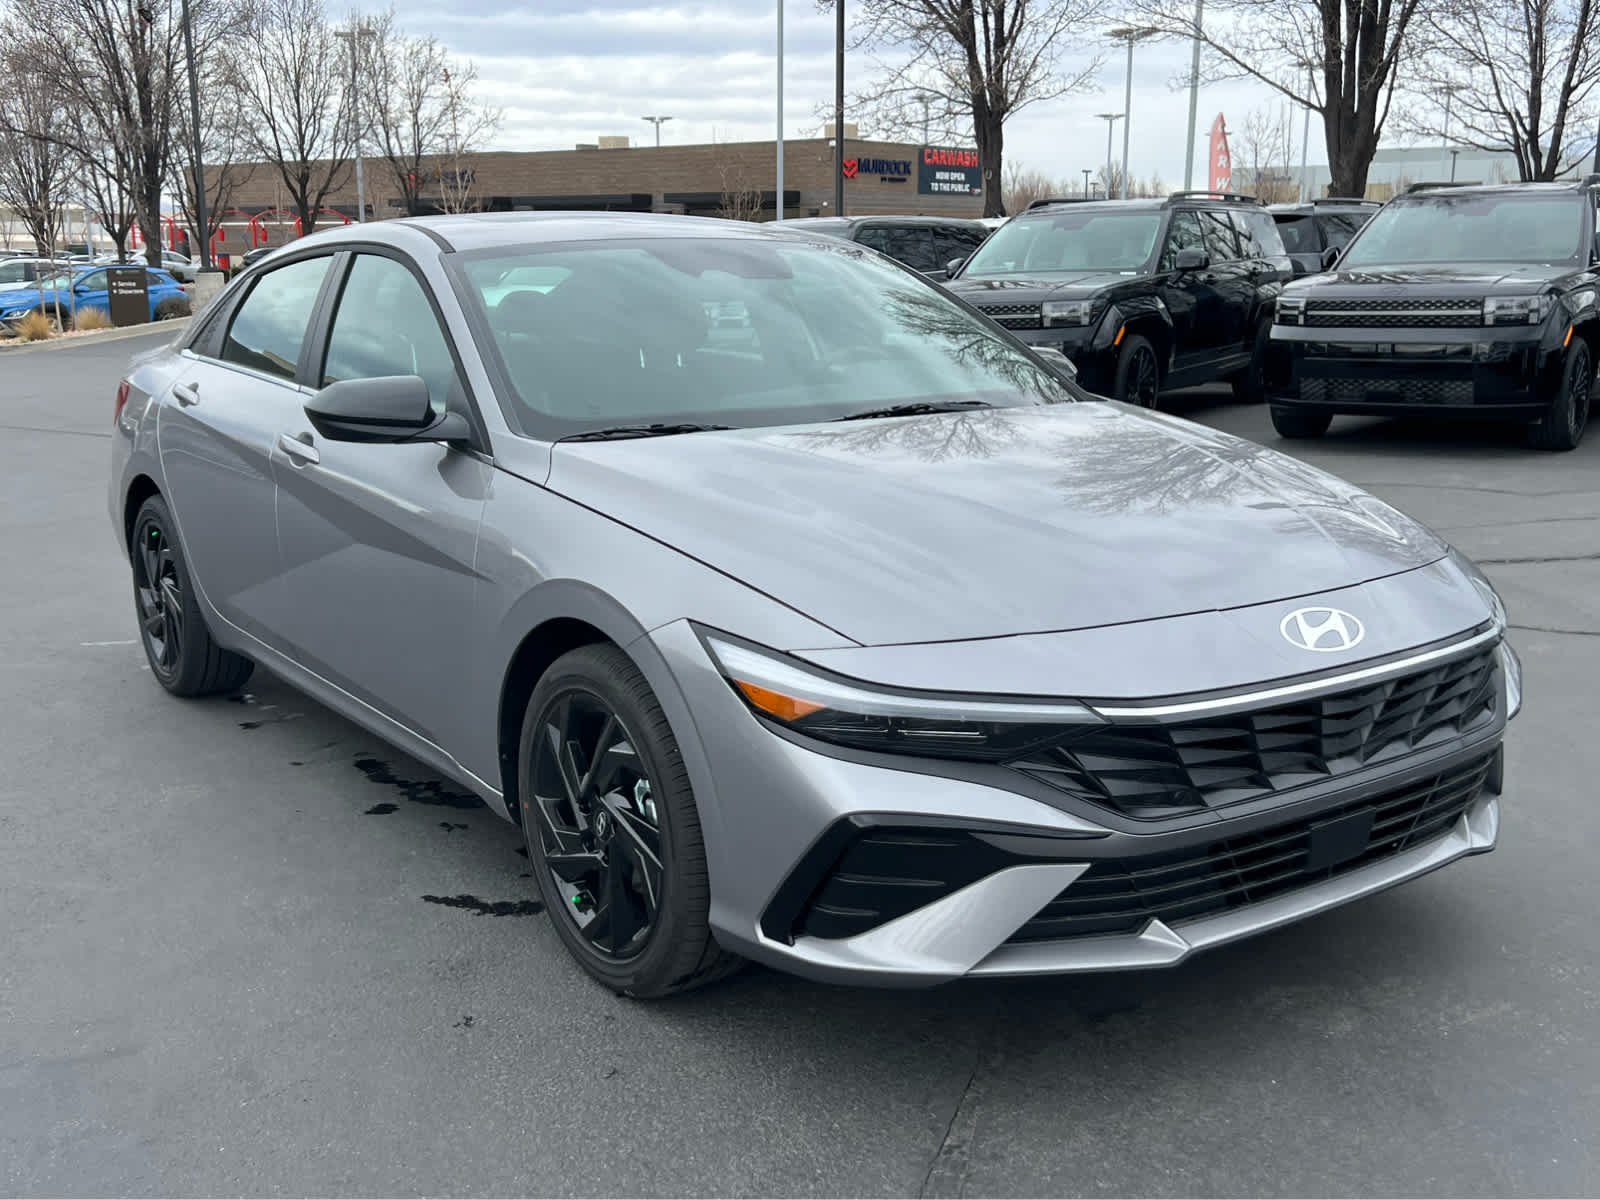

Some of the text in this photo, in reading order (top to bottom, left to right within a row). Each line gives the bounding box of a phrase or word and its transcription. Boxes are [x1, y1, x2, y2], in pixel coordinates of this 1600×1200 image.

[924, 149, 978, 167] CARWASH
[857, 158, 912, 175] MURDOCK
[936, 171, 965, 182] NOW OPEN
[931, 182, 939, 192] TO
[939, 183, 950, 192] THE
[950, 183, 970, 193] PUBLIC
